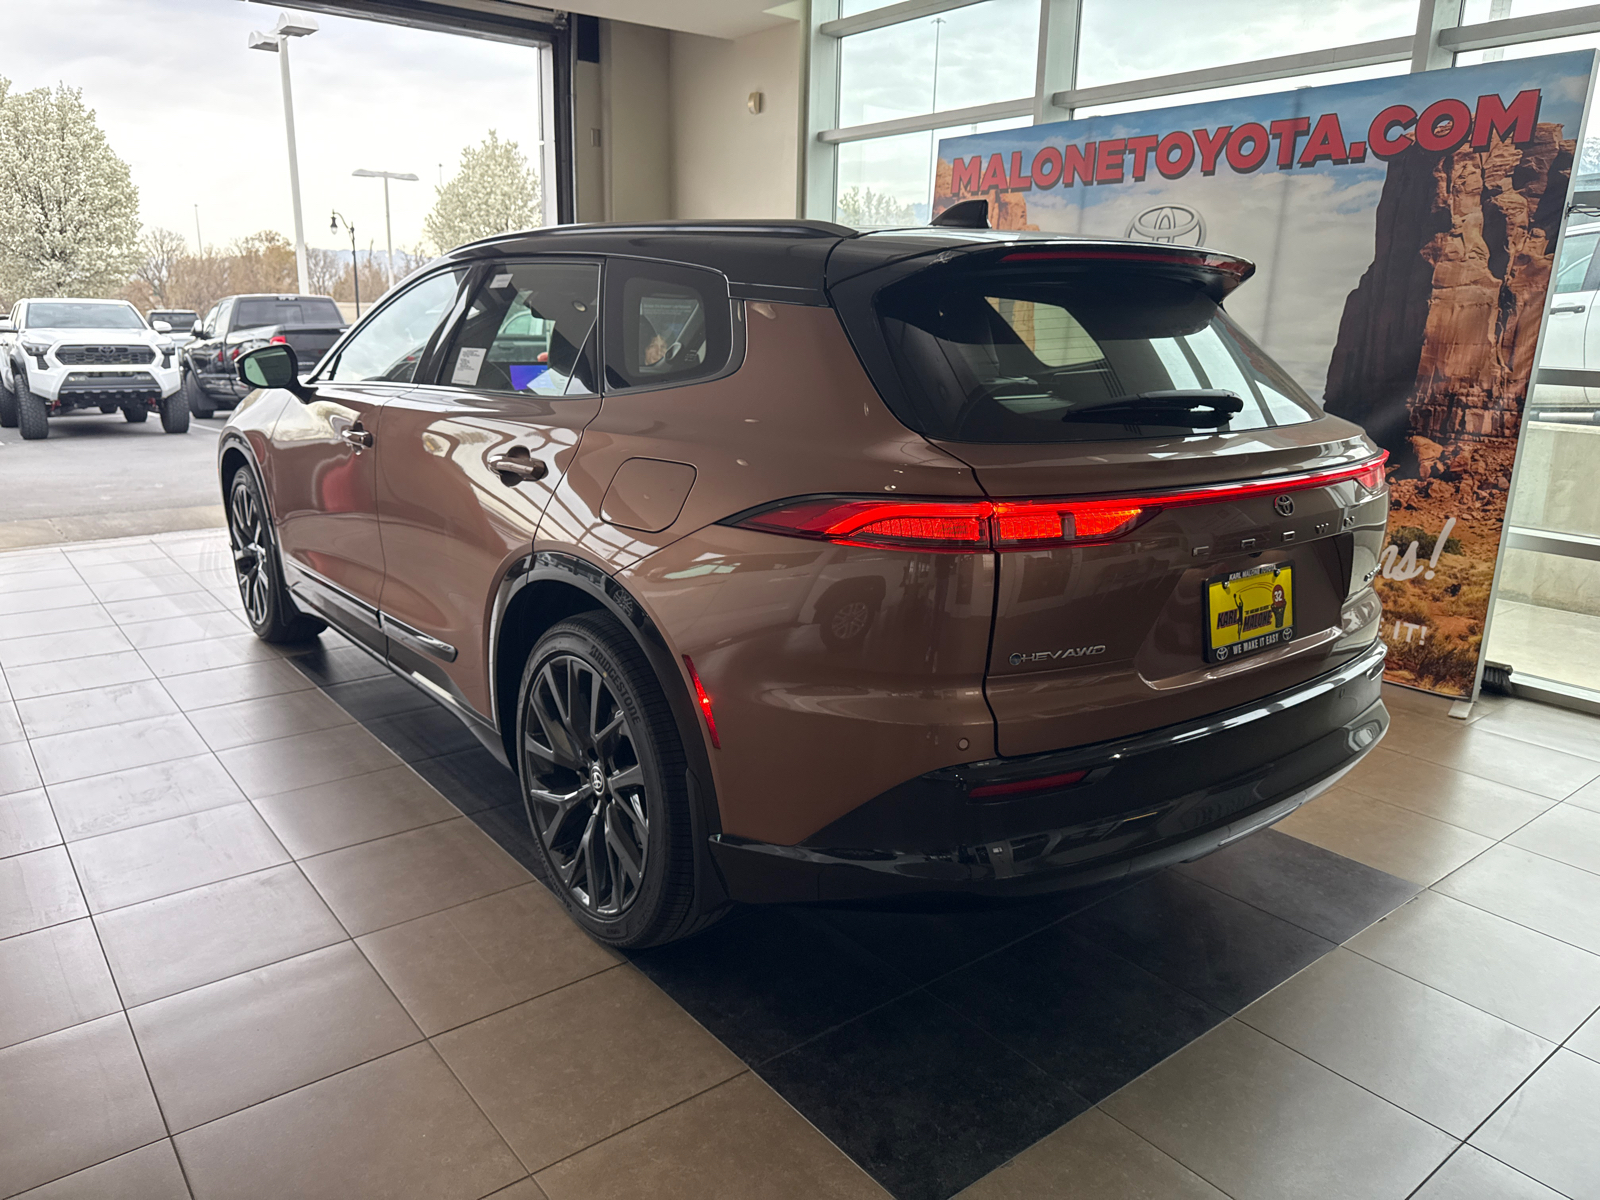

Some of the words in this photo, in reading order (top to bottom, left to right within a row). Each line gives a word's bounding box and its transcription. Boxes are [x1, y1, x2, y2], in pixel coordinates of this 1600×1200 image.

[950, 89, 1541, 197] MALONETOYOTA.COM
[1229, 571, 1242, 581] KARL
[1274, 590, 1283, 602] 32
[1216, 608, 1239, 630] KARL
[1242, 609, 1273, 633] MALONE
[1232, 644, 1242, 655] WE
[1243, 639, 1259, 652] MAKE
[1259, 638, 1265, 647] IT
[1265, 633, 1279, 645] EASY
[1393, 620, 1428, 646] IT!
[588, 644, 642, 726] BRIDGESTONE
